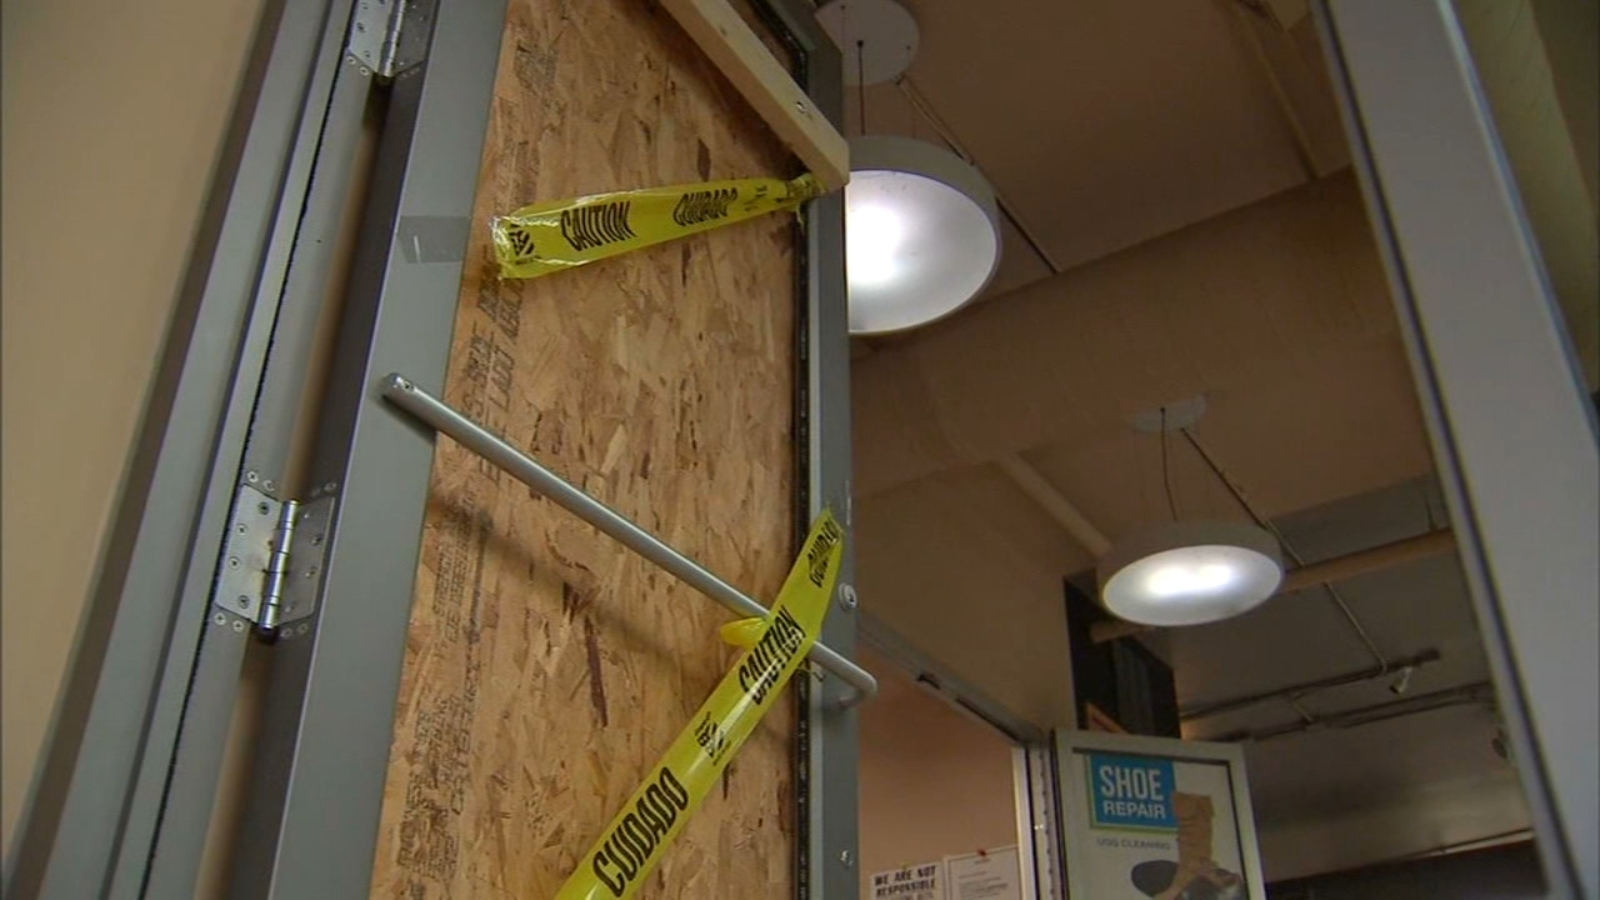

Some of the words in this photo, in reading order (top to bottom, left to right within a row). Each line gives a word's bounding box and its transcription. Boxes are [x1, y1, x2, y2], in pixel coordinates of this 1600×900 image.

[561, 201, 636, 251] CAUTION
[673, 187, 738, 226] CUIDADO
[592, 766, 689, 898] CUIDADO
[739, 604, 806, 705] CAUTION
[1100, 765, 1164, 800] SHOE
[1103, 800, 1166, 819] REPAIR
[1121, 838, 1171, 851] CLEANING
[874, 875, 889, 886] WE
[893, 869, 912, 882] ARE
[917, 865, 936, 879] NOT
[876, 879, 936, 896] RESPONSIBLE
